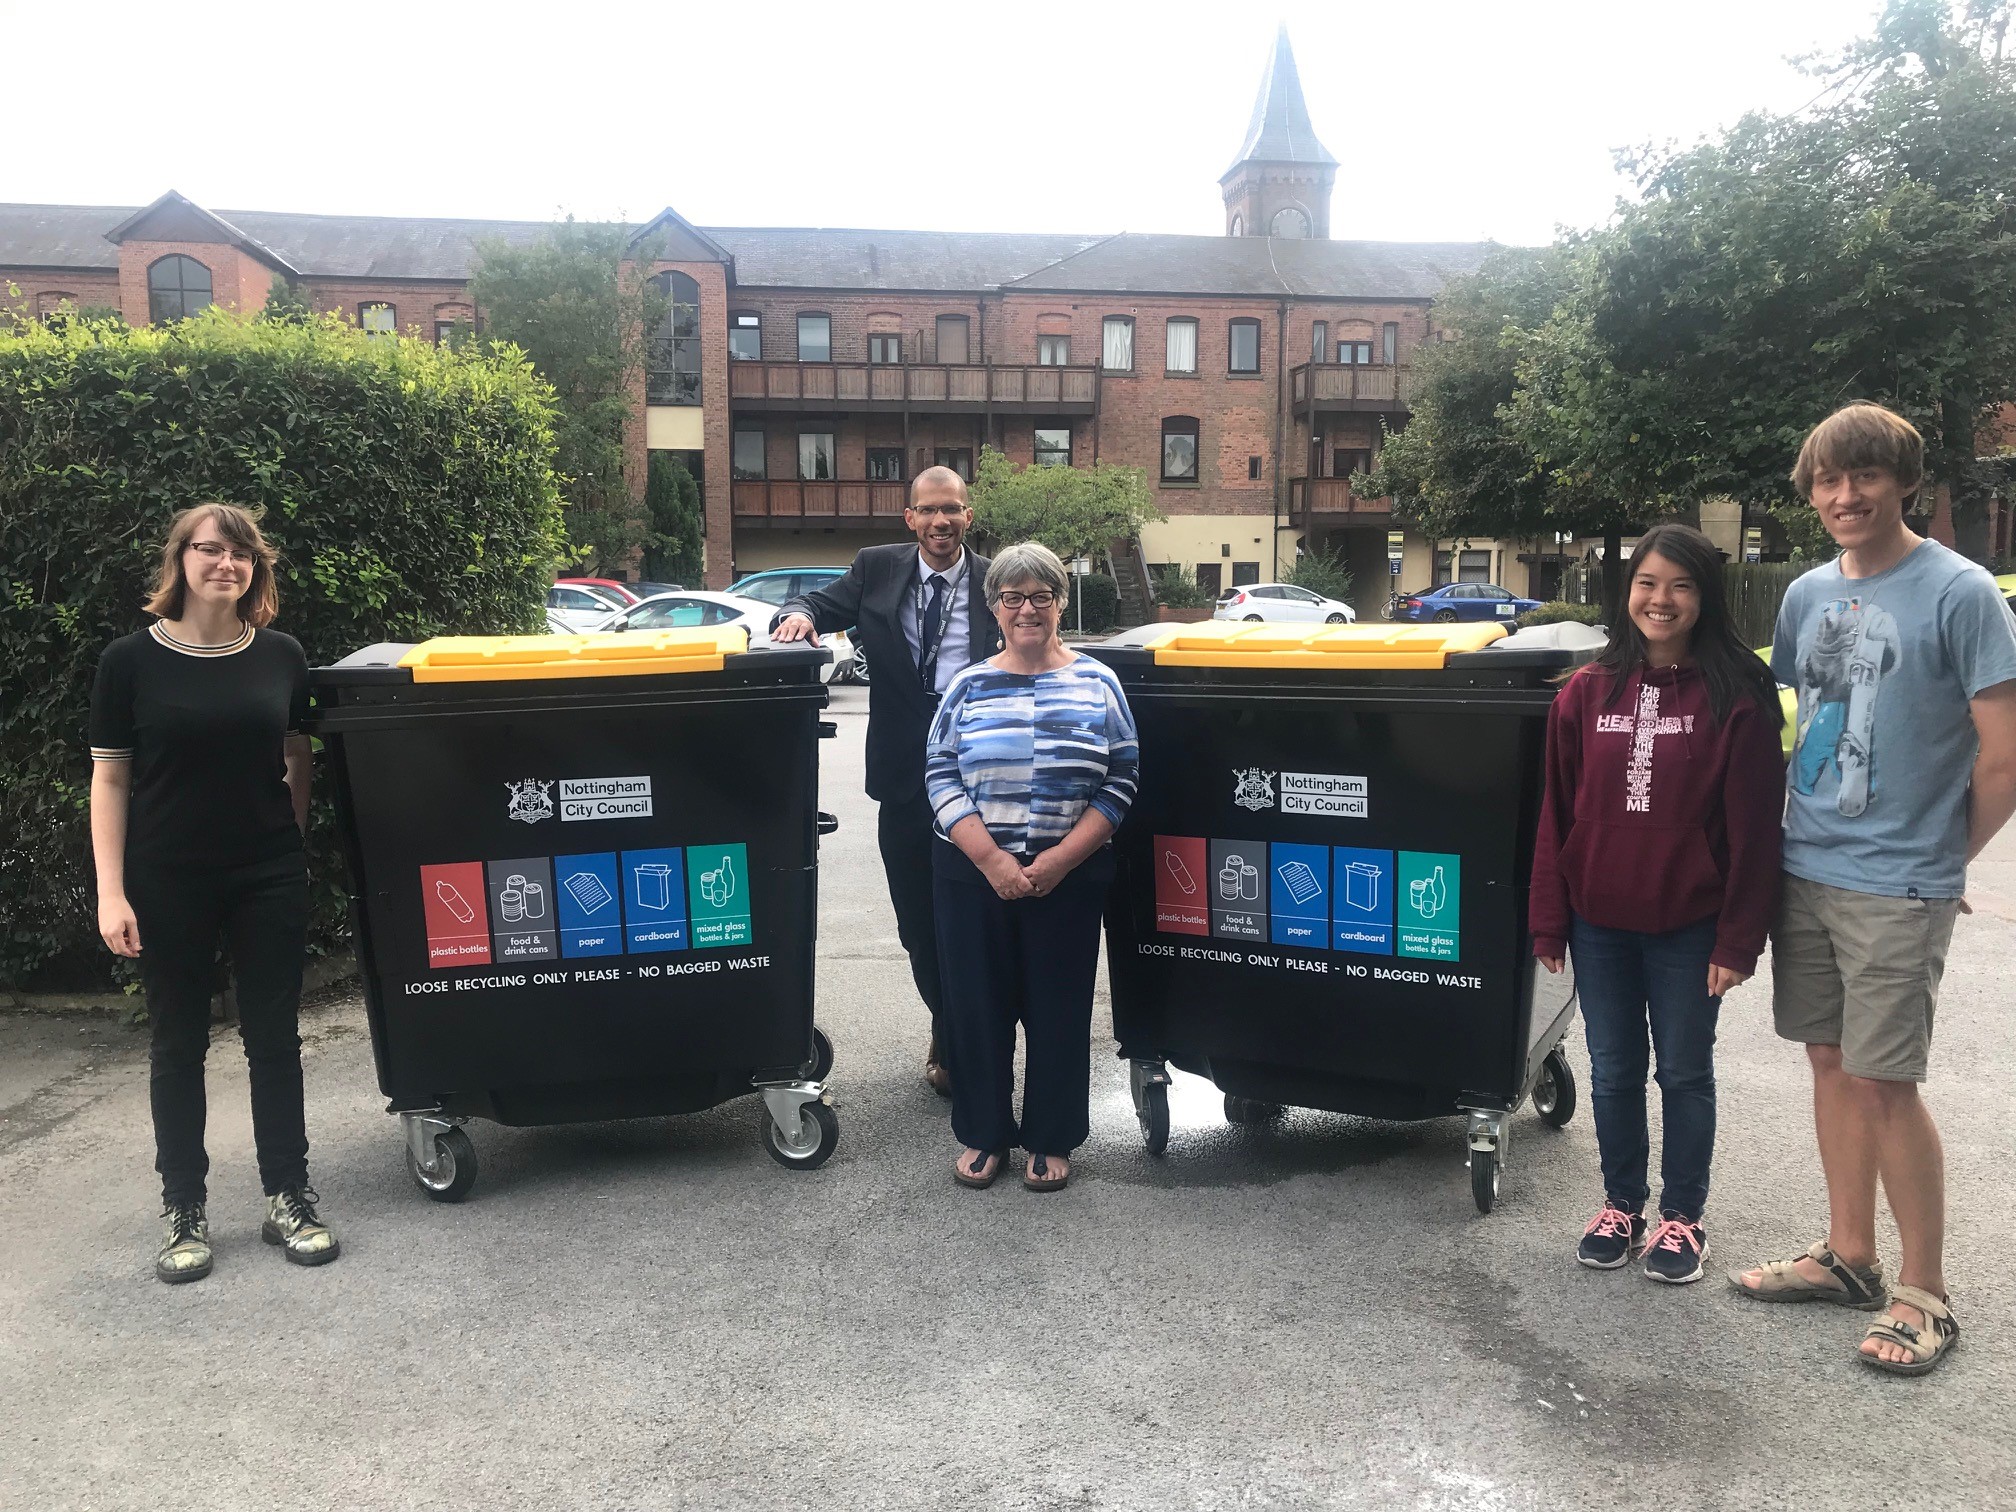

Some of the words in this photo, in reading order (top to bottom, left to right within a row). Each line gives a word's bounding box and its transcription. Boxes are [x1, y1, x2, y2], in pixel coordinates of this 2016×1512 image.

[565, 780, 646, 797] Nottingham
[1285, 776, 1363, 793] Nottingham
[565, 803, 593, 818] City
[596, 799, 647, 814] Council
[1285, 796, 1311, 812] City
[1315, 797, 1365, 812] Council
[1627, 800, 1650, 811] ME
[1158, 913, 1181, 923] plastic
[1182, 915, 1206, 924] bottles
[1226, 914, 1244, 925] food
[1246, 917, 1253, 925] &
[697, 924, 720, 933] mixed
[722, 921, 746, 933] glass
[1220, 922, 1242, 932] drink
[1287, 927, 1312, 938] paper
[511, 935, 529, 945] food
[529, 936, 540, 944] &
[635, 930, 679, 941] cardboard
[731, 932, 745, 943] jars
[1341, 932, 1385, 942] cardboard
[1403, 933, 1430, 943] mixed
[1431, 936, 1453, 948] glass
[578, 937, 605, 949] paper
[431, 946, 457, 958] plastic
[459, 945, 488, 953] bottles
[505, 946, 526, 955] drink
[528, 946, 549, 954] cans
[1406, 944, 1428, 952] bottles
[1430, 945, 1436, 953] &
[1436, 947, 1452, 957] jars
[1139, 944, 1174, 956] LOOSE
[1181, 948, 1241, 963] RECYCLING
[1248, 955, 1279, 967] ONLY
[1286, 959, 1327, 973] PLEASE
[1347, 965, 1367, 977] NO
[1374, 968, 1429, 983] BAGGED
[1437, 974, 1481, 988] WASTE
[405, 982, 449, 995] LOOSE
[455, 975, 526, 990] RECYCLING
[533, 972, 568, 985] ONLY
[575, 969, 619, 981] PLEASE
[639, 966, 659, 977] NO
[667, 961, 721, 975] BAGGED
[728, 956, 769, 970] WASTE
